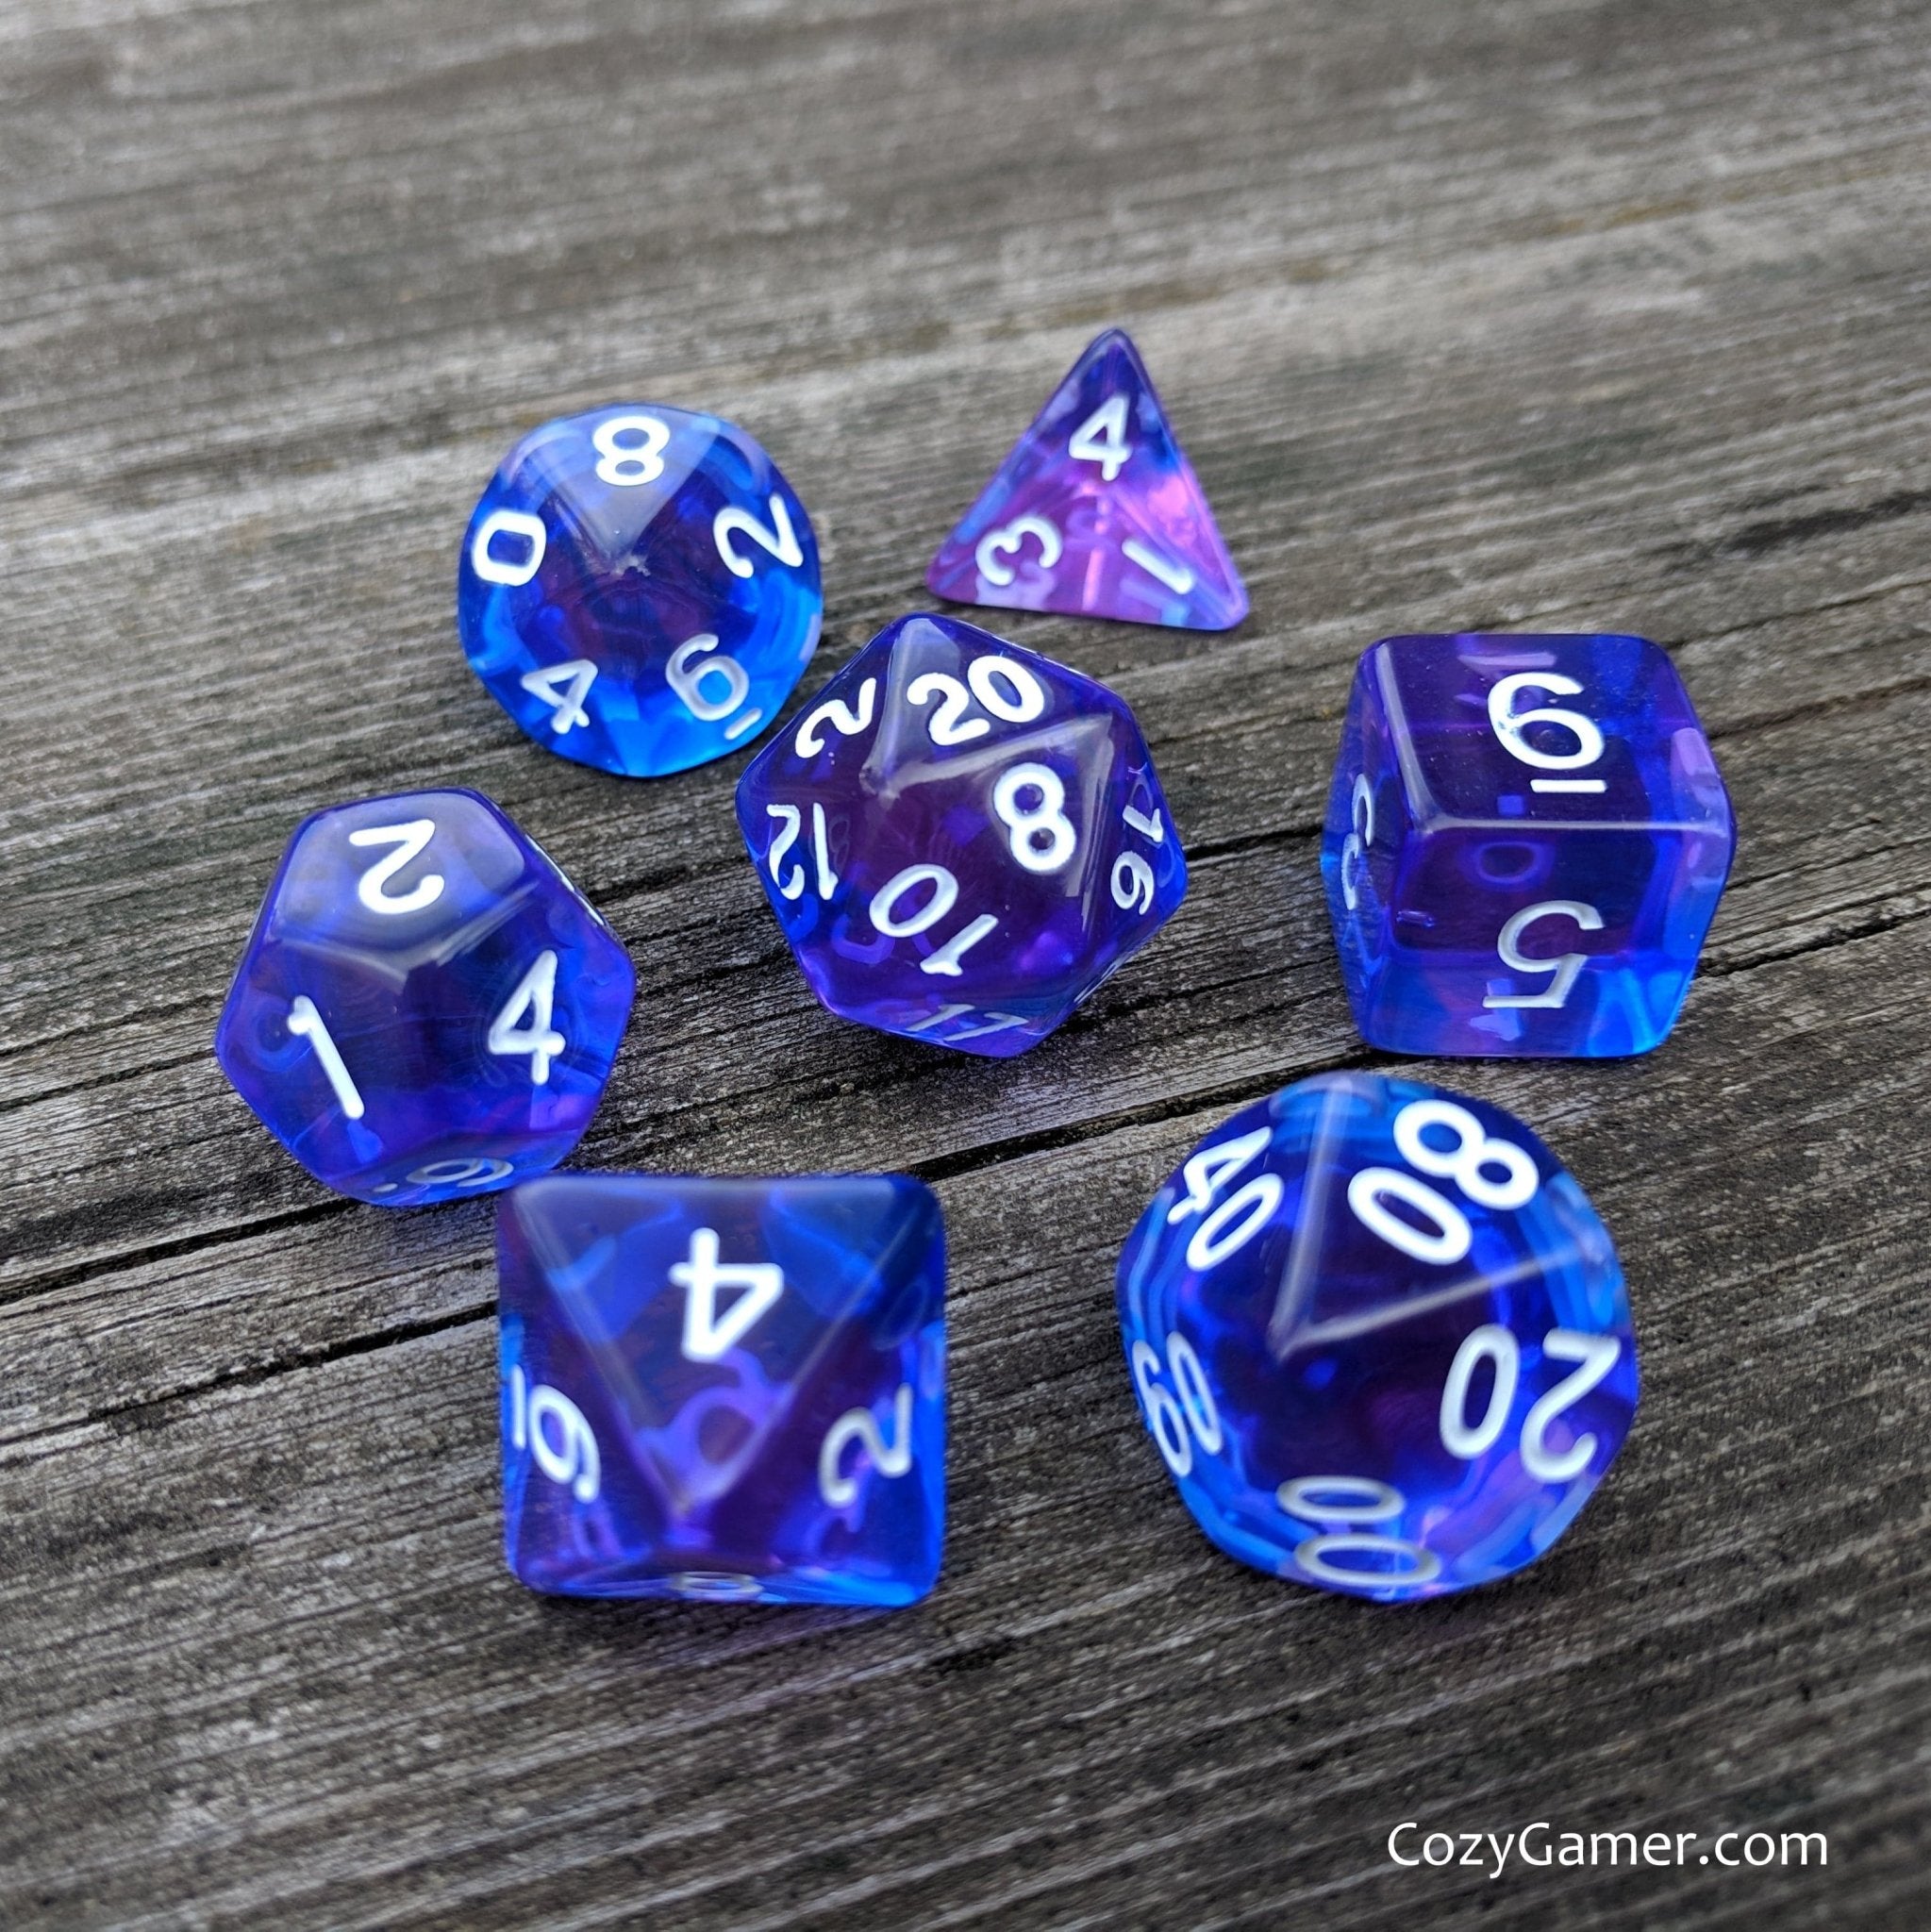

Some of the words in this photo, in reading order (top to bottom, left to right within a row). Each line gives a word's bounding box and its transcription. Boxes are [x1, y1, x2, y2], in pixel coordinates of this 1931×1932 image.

[592, 415, 670, 487] 8
[1069, 396, 1132, 481] 4
[474, 508, 546, 586] 0
[713, 492, 804, 578] 2
[975, 515, 1062, 586] 3
[1121, 539, 1194, 594] 1
[521, 658, 598, 734] 4
[665, 634, 762, 740] 6
[794, 677, 877, 758] 2
[907, 655, 1044, 746] 20
[1488, 672, 1607, 794] 6
[348, 819, 445, 915] 2
[766, 802, 839, 901] 12
[993, 761, 1076, 872] 8
[1340, 774, 1375, 910] 3
[869, 863, 999, 977] 10
[1482, 900, 1605, 1008] 5
[287, 995, 365, 1120] 1
[489, 950, 567, 1085] 4
[1167, 1125, 1285, 1271] 40
[1347, 1099, 1540, 1265] 80
[668, 1227, 785, 1362] 4
[510, 1364, 602, 1504] 6
[818, 1383, 924, 1508] 2
[1132, 1330, 1223, 1478] 60
[1439, 1324, 1621, 1483] 20
[1276, 1474, 1442, 1587] 00
